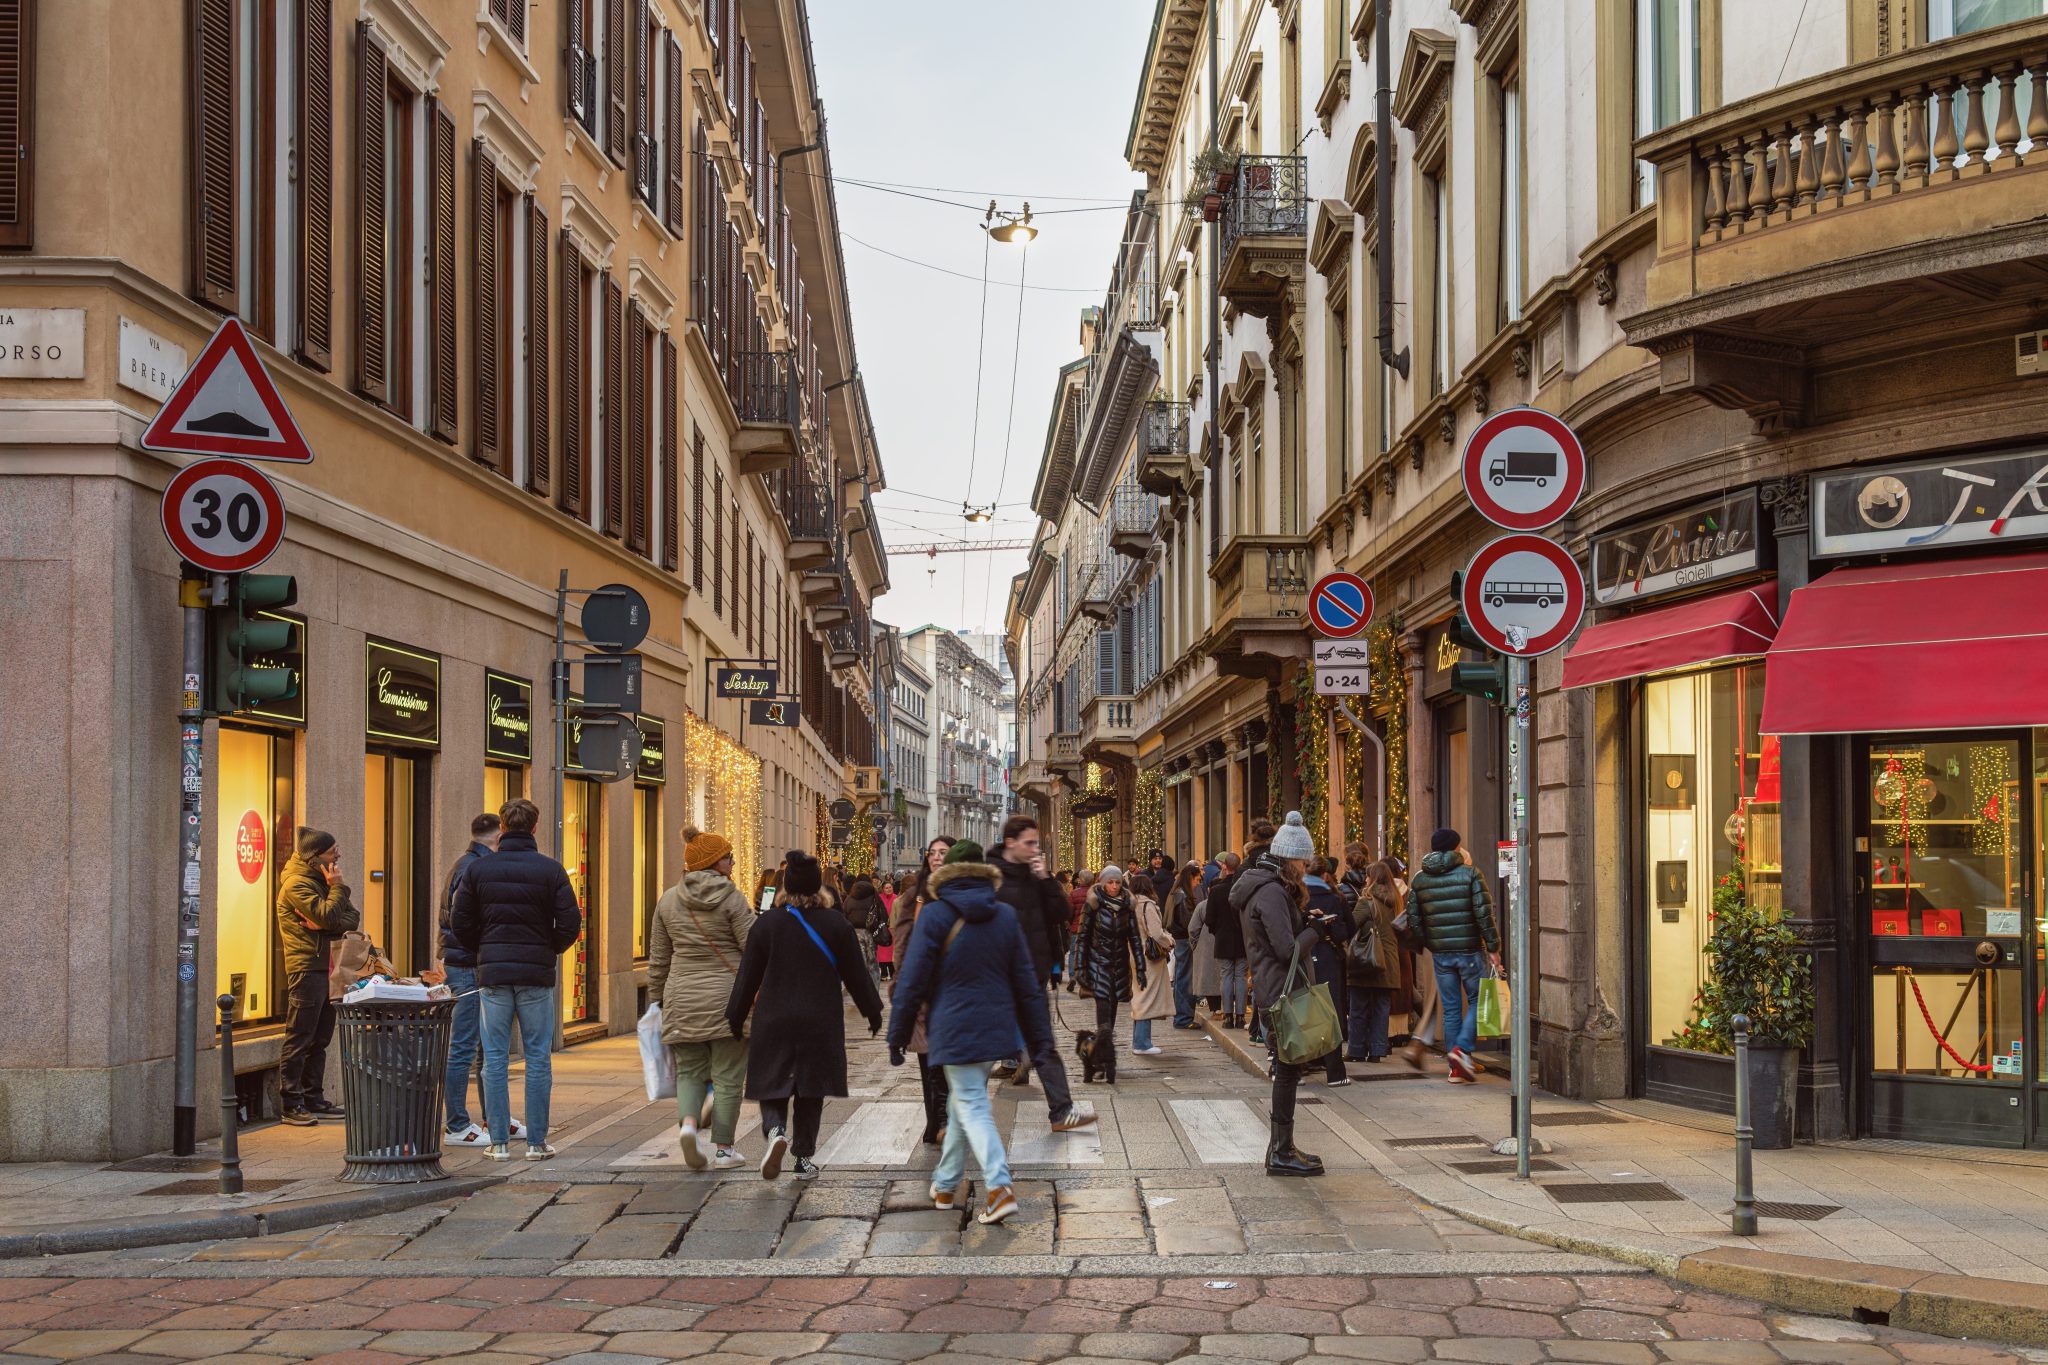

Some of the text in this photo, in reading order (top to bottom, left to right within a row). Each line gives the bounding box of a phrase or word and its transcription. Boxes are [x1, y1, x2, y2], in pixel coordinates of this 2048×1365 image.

[149, 337, 160, 351] VIA
[131, 358, 176, 391] BRERA
[191, 488, 261, 543] 30
[1675, 562, 1714, 586] Gioielli
[378, 667, 428, 712] Camicissima
[1324, 675, 1361, 687] 0-24
